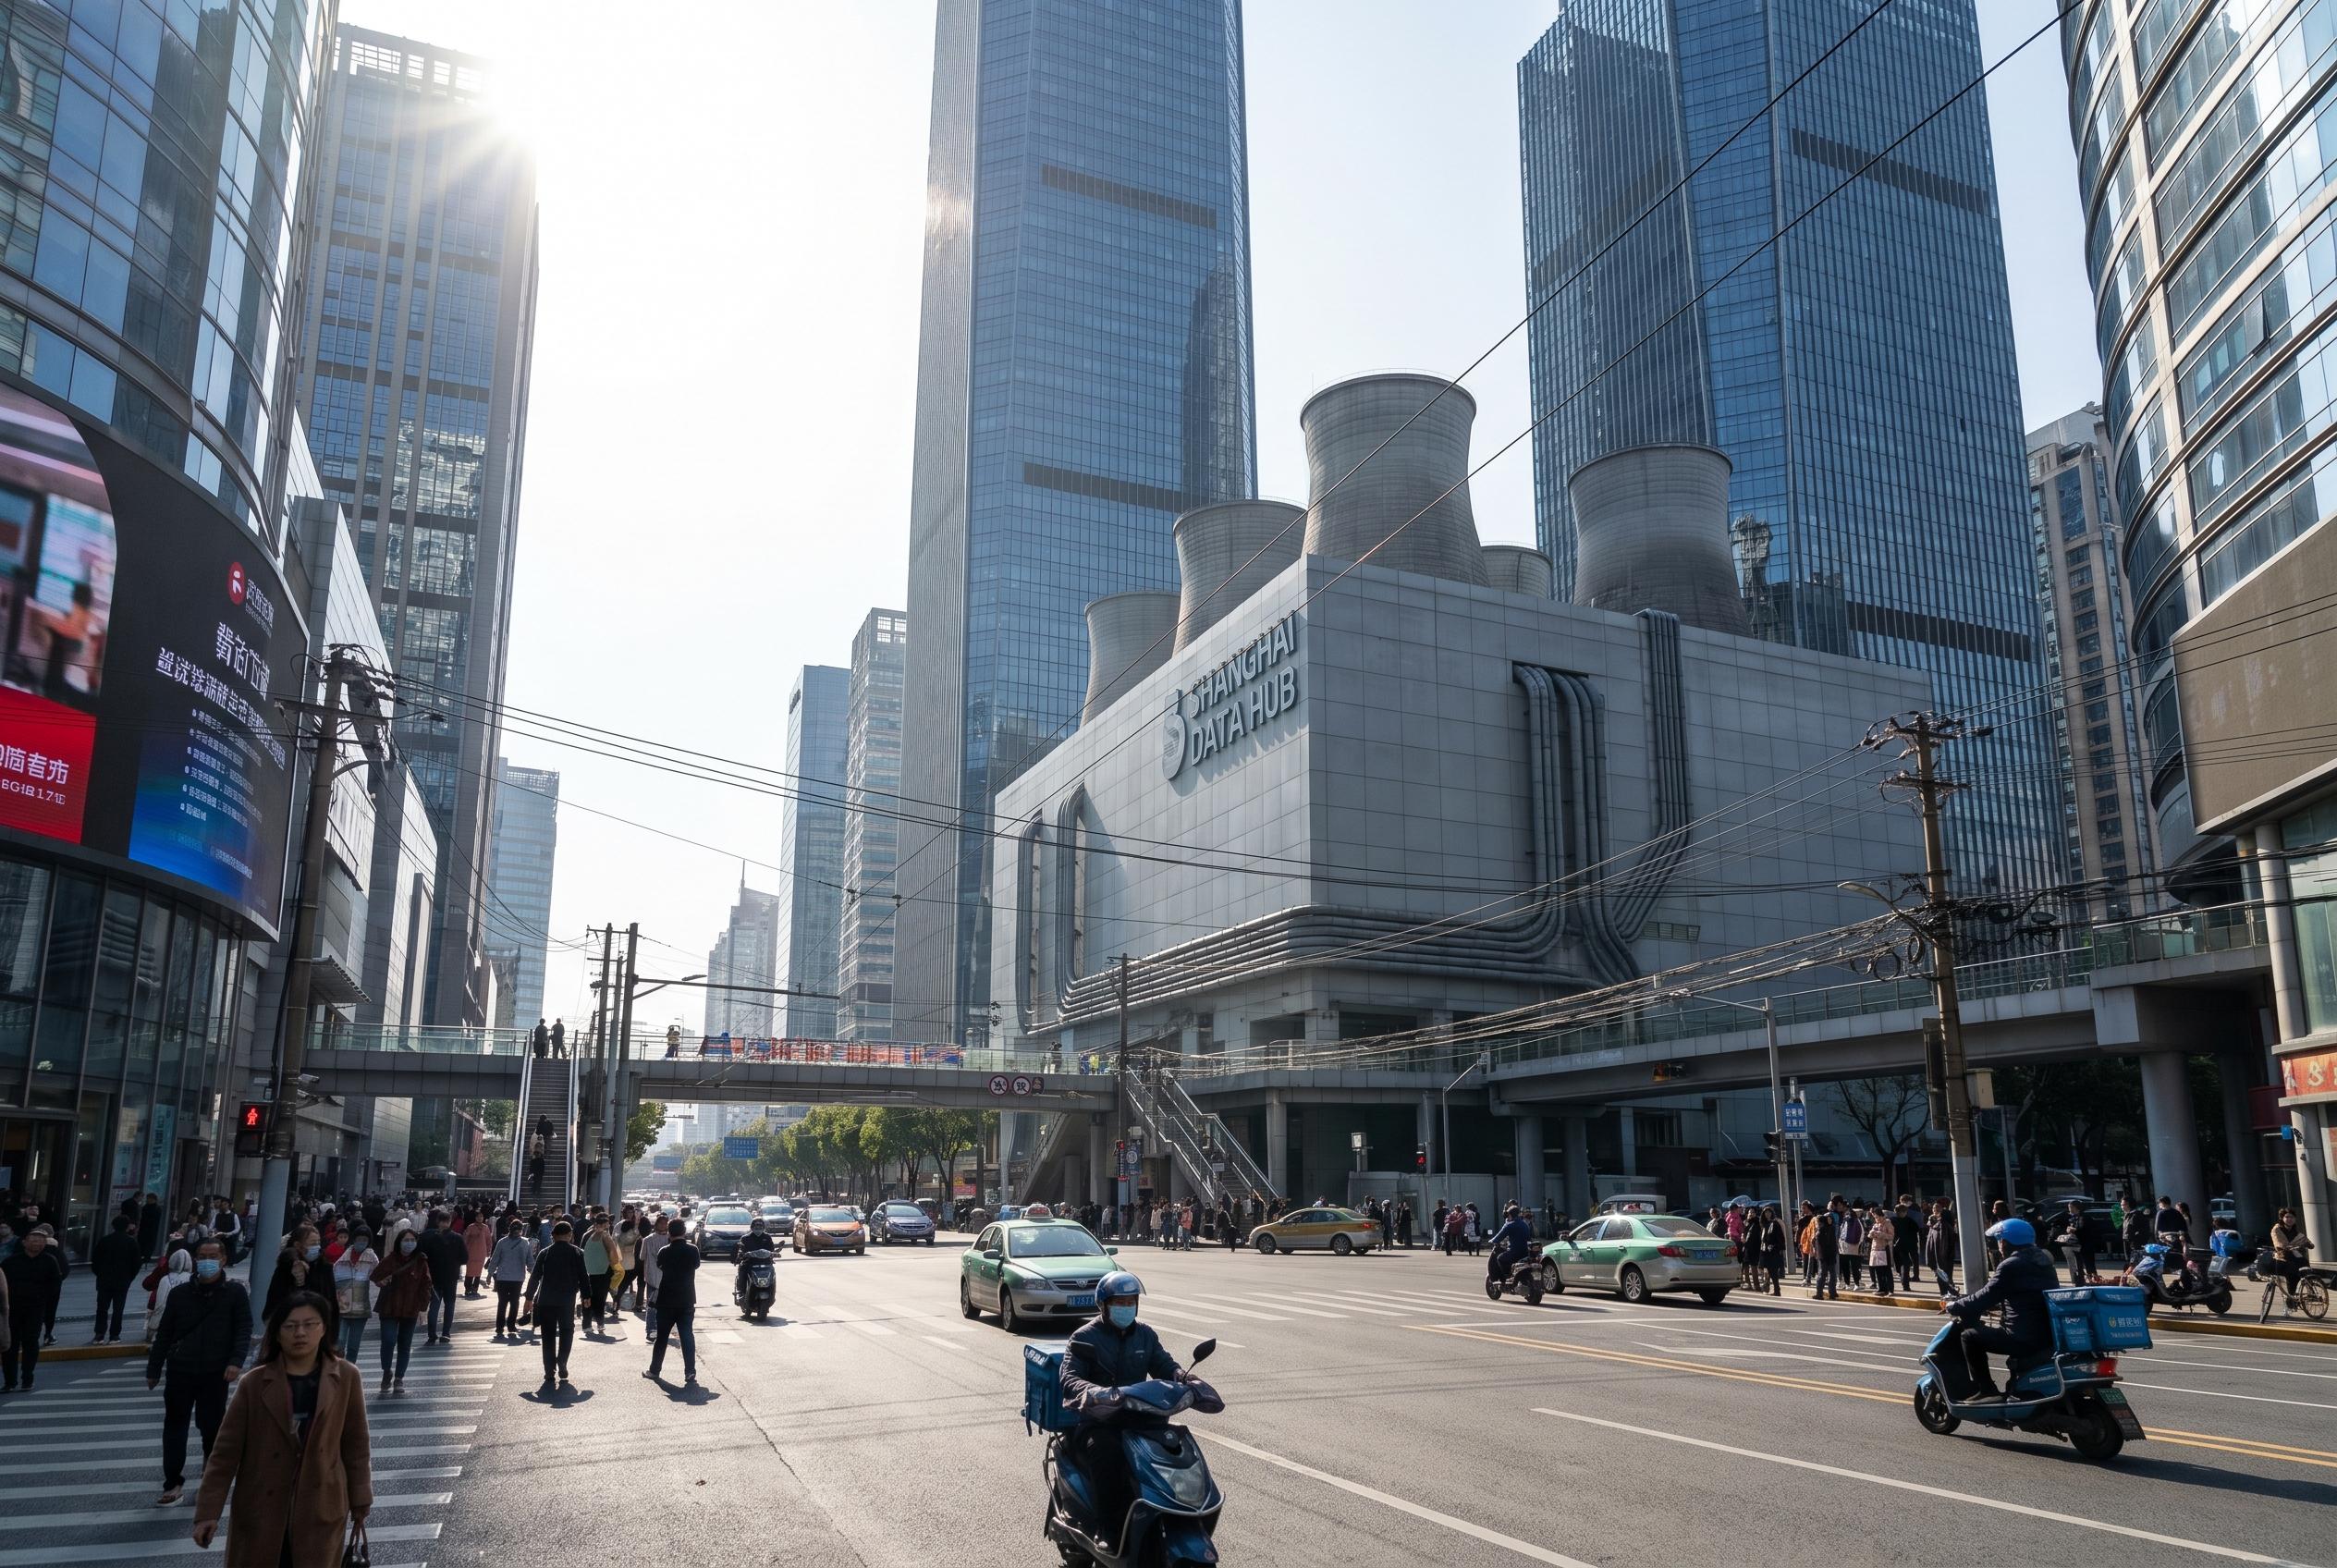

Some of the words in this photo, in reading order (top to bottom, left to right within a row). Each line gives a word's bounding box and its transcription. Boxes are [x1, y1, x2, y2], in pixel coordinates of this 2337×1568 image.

[1190, 613, 1294, 719] SHANGHAI
[1191, 701, 1247, 766] DATA
[1250, 666, 1295, 730] HUB
